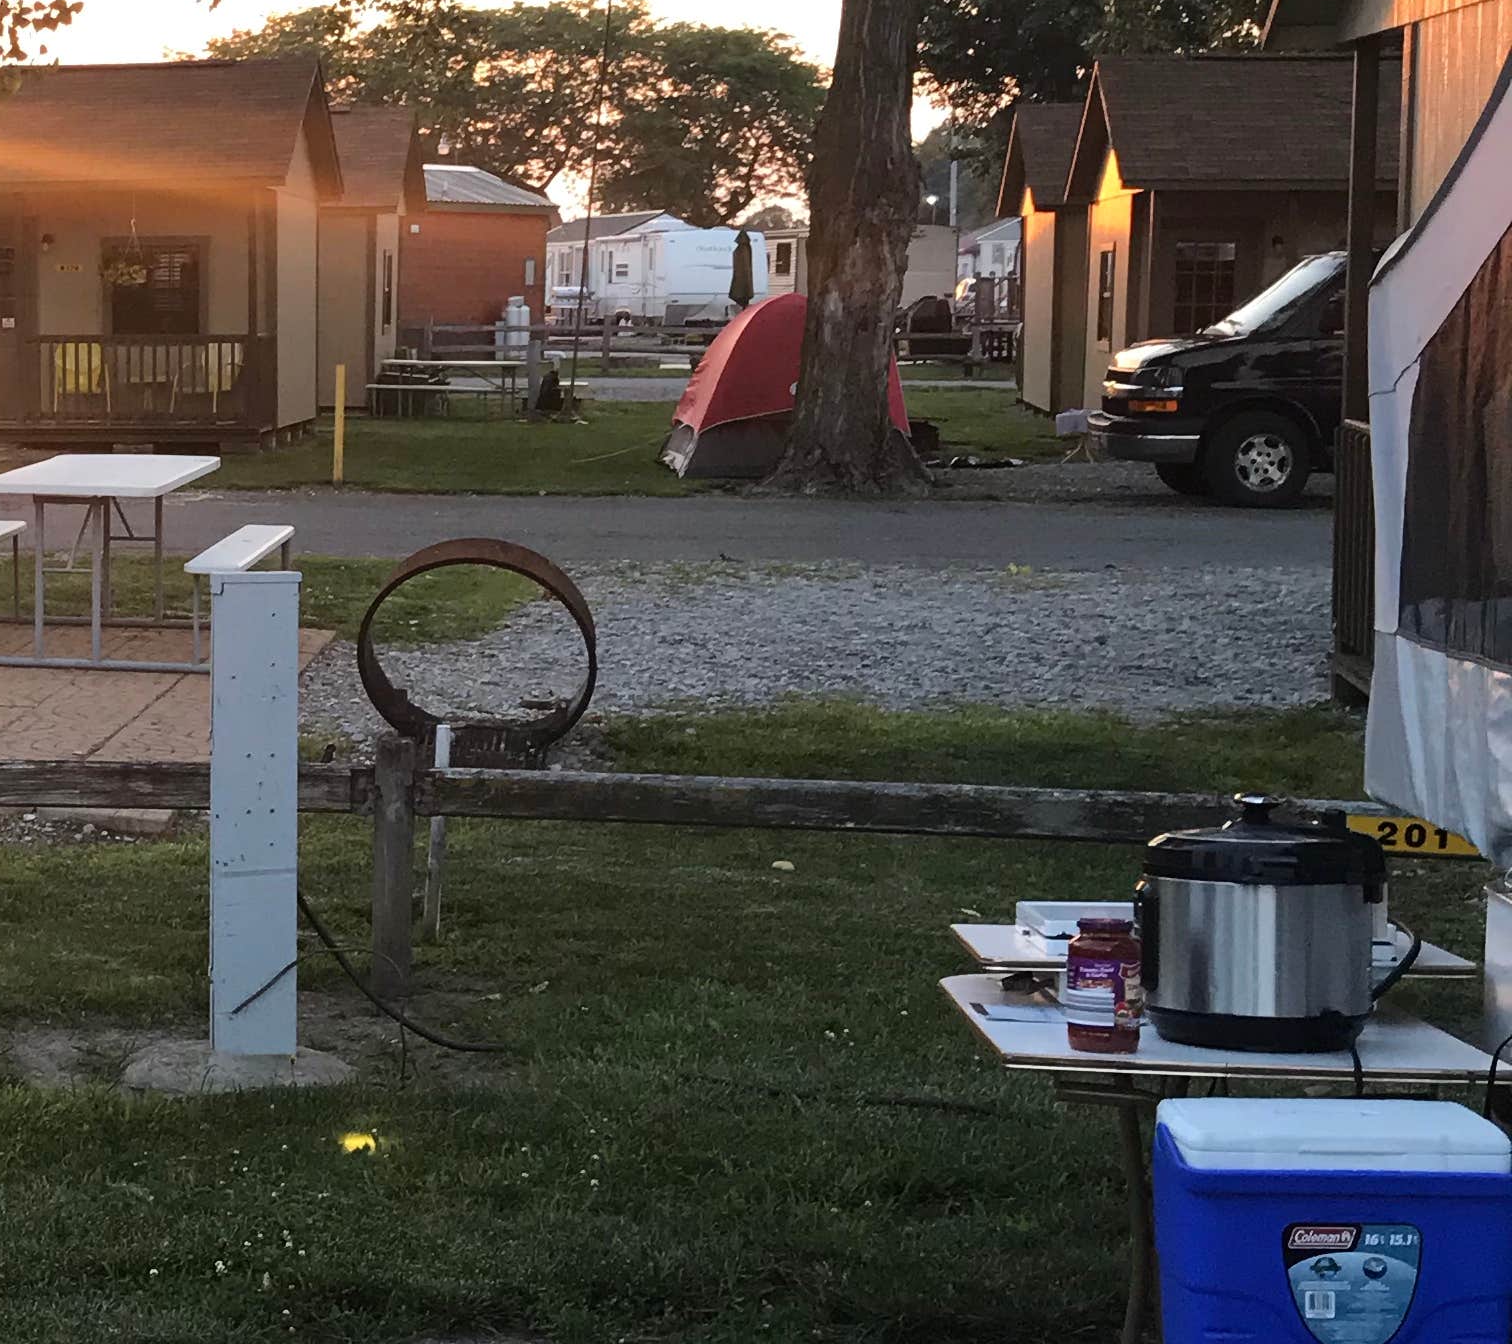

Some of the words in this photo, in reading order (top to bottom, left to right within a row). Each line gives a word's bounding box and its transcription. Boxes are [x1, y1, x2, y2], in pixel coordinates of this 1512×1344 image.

[1377, 821, 1449, 850] 201
[1294, 1230, 1340, 1244] Coleman
[1364, 1233, 1380, 1246] 16
